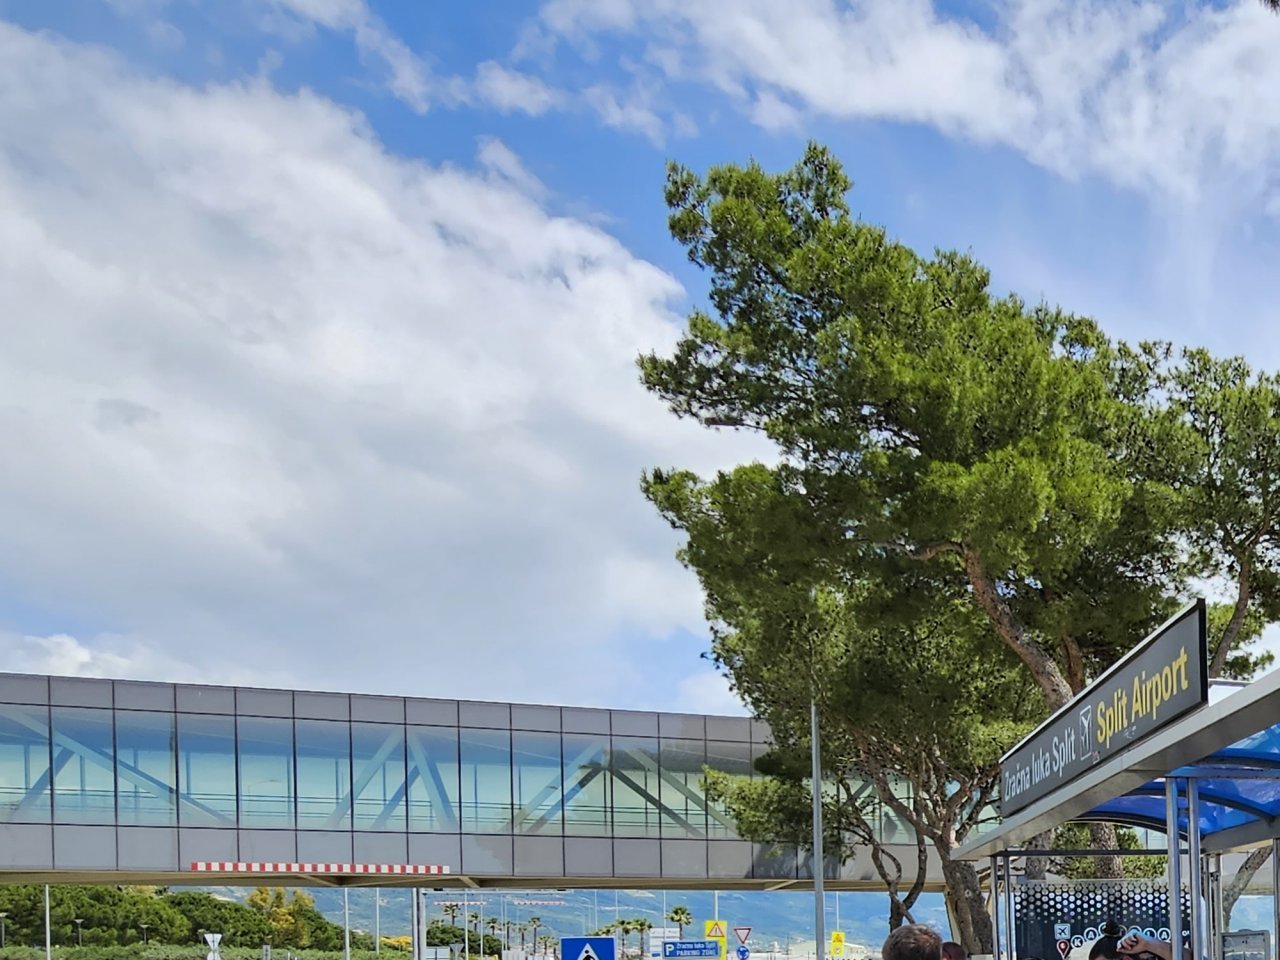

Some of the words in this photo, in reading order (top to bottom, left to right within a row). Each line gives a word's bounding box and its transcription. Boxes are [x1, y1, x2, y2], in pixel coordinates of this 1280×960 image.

[1096, 687, 1128, 749] Split
[1131, 646, 1189, 722] Airport
[1003, 765, 1030, 802] Zračna
[1032, 752, 1050, 785] luka
[1052, 728, 1076, 778] Split
[665, 944, 674, 956] P
